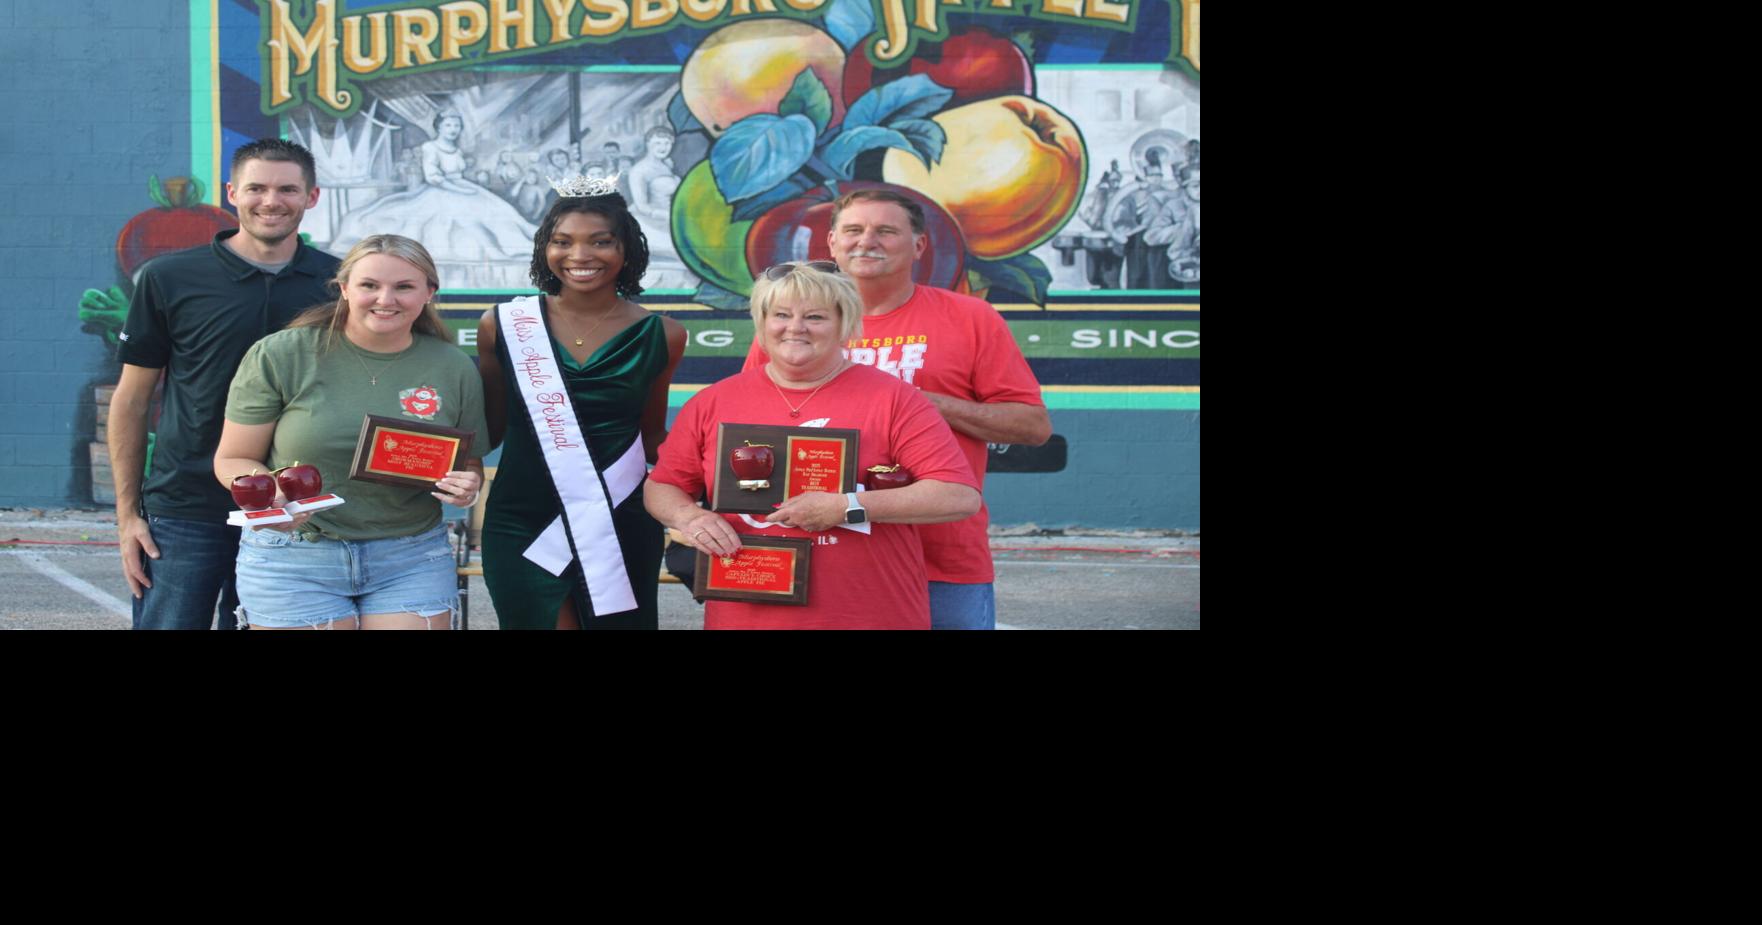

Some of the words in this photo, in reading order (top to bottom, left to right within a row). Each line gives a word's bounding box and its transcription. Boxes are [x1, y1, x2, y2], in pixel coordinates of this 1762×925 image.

[509, 307, 540, 344] Miss
[515, 345, 553, 390] Apple
[536, 391, 580, 452] Festival
